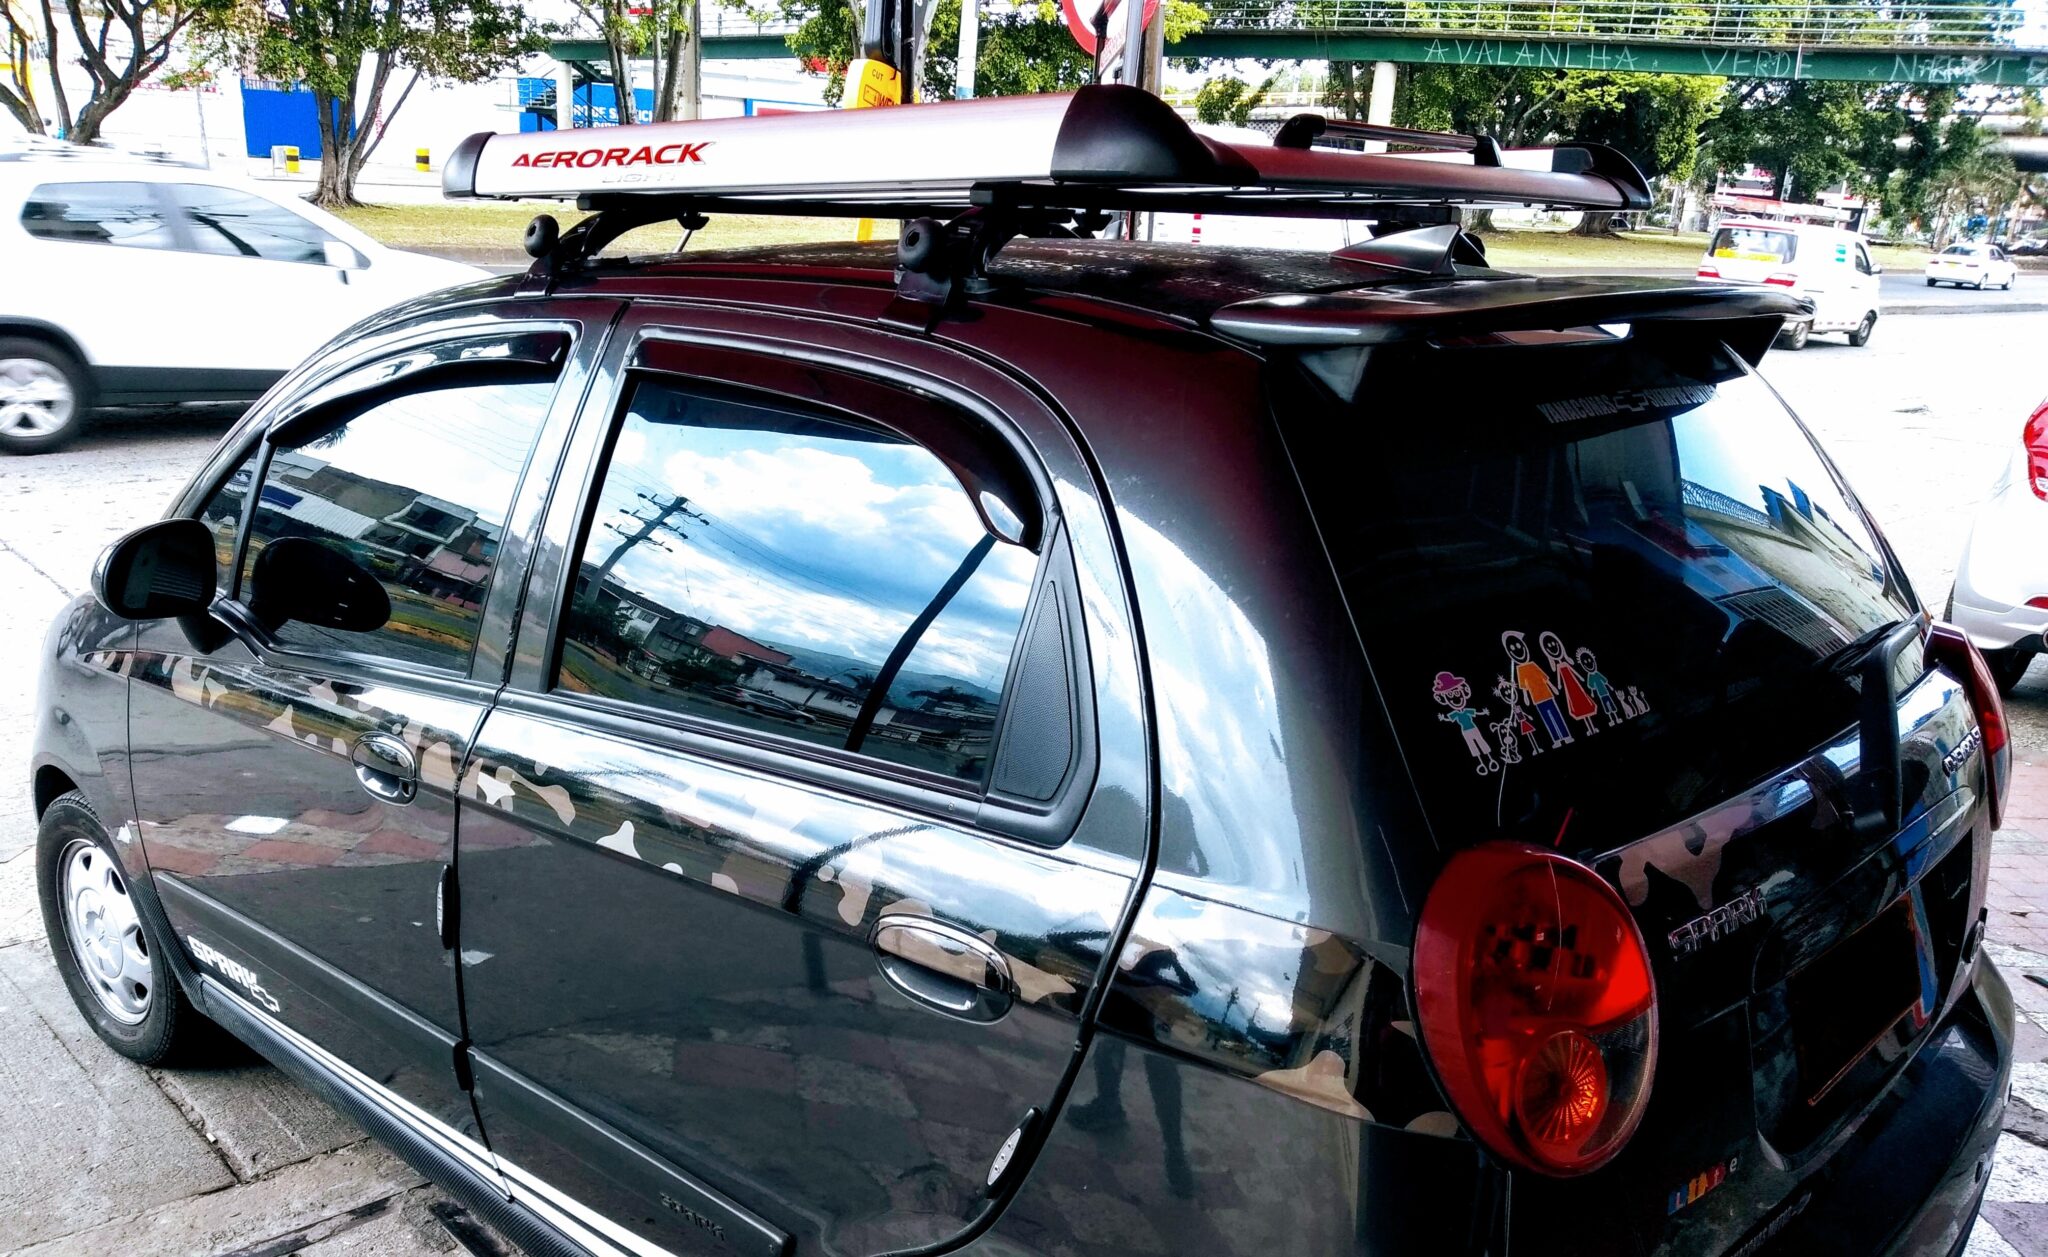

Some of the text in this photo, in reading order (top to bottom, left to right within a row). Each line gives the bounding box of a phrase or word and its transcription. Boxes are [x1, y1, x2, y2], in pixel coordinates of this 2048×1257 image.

[1701, 48, 1814, 80] VERDE
[511, 141, 711, 168] AERORACK
[1667, 886, 1768, 953] SPARK
[186, 934, 258, 989] SPARK
